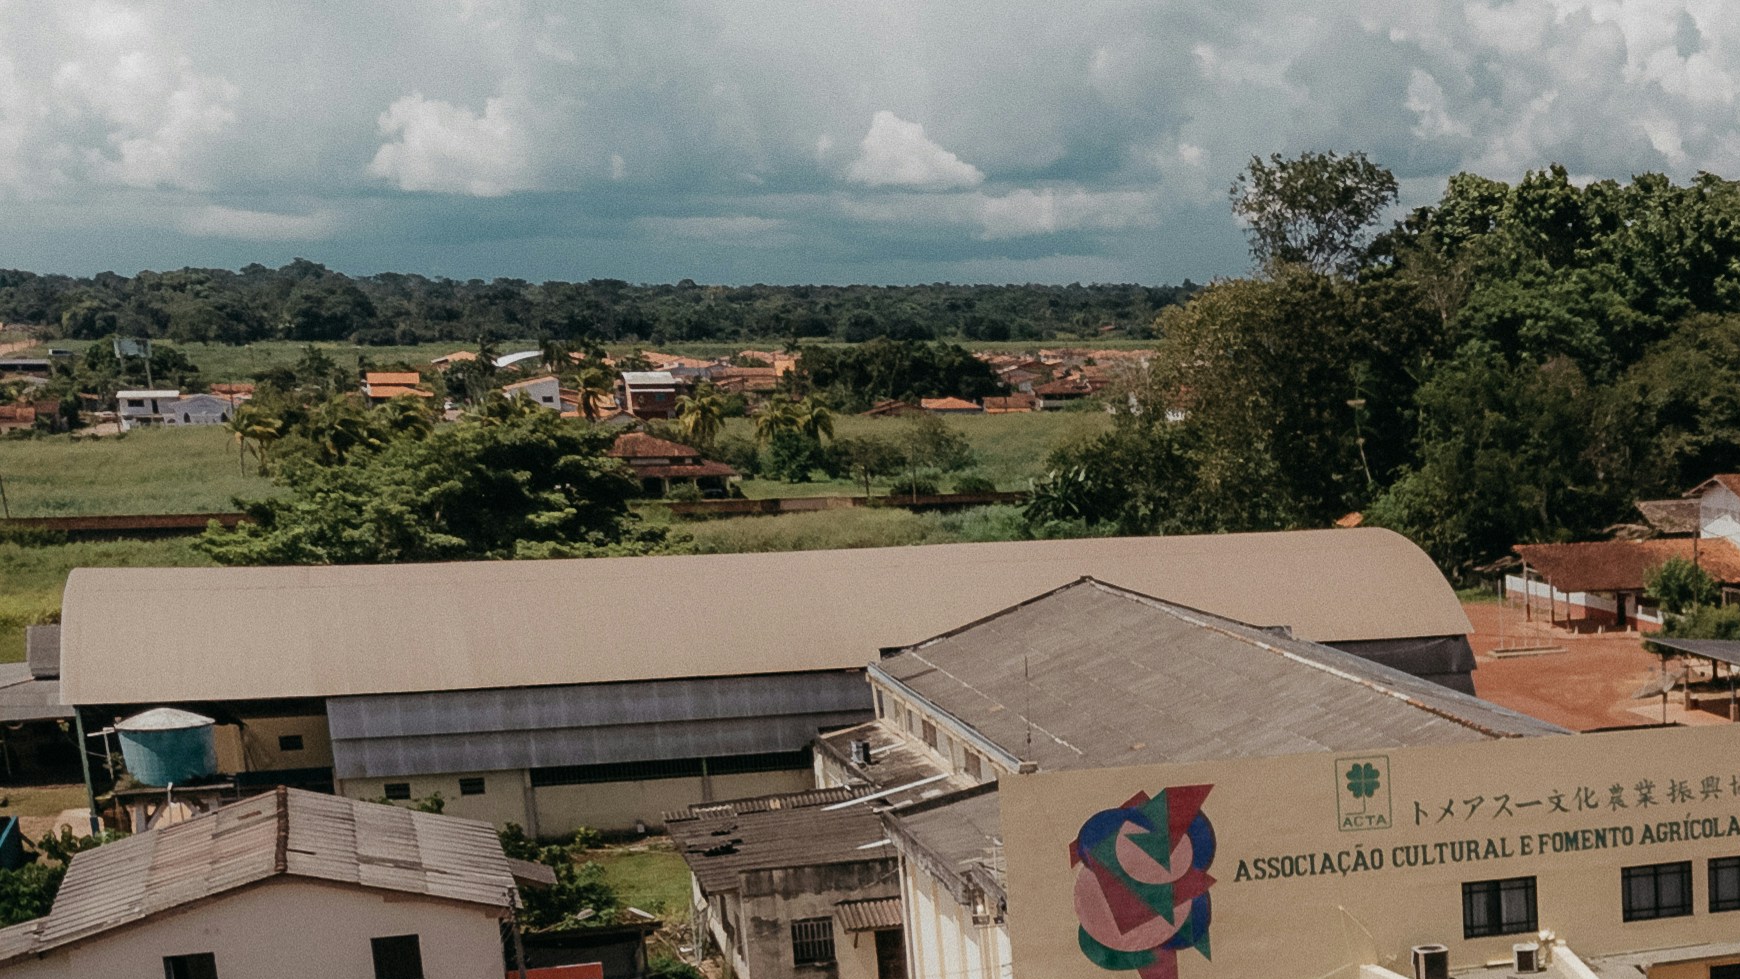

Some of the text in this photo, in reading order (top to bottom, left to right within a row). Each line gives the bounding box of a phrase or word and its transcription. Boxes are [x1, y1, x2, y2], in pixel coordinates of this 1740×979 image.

[1343, 814, 1387, 828] ACTA
[1233, 844, 1384, 882] ASSOCIAÇÃO
[1392, 837, 1515, 868] CULTURAL
[1520, 835, 1533, 856] E
[1538, 826, 1634, 855] FOMENTO
